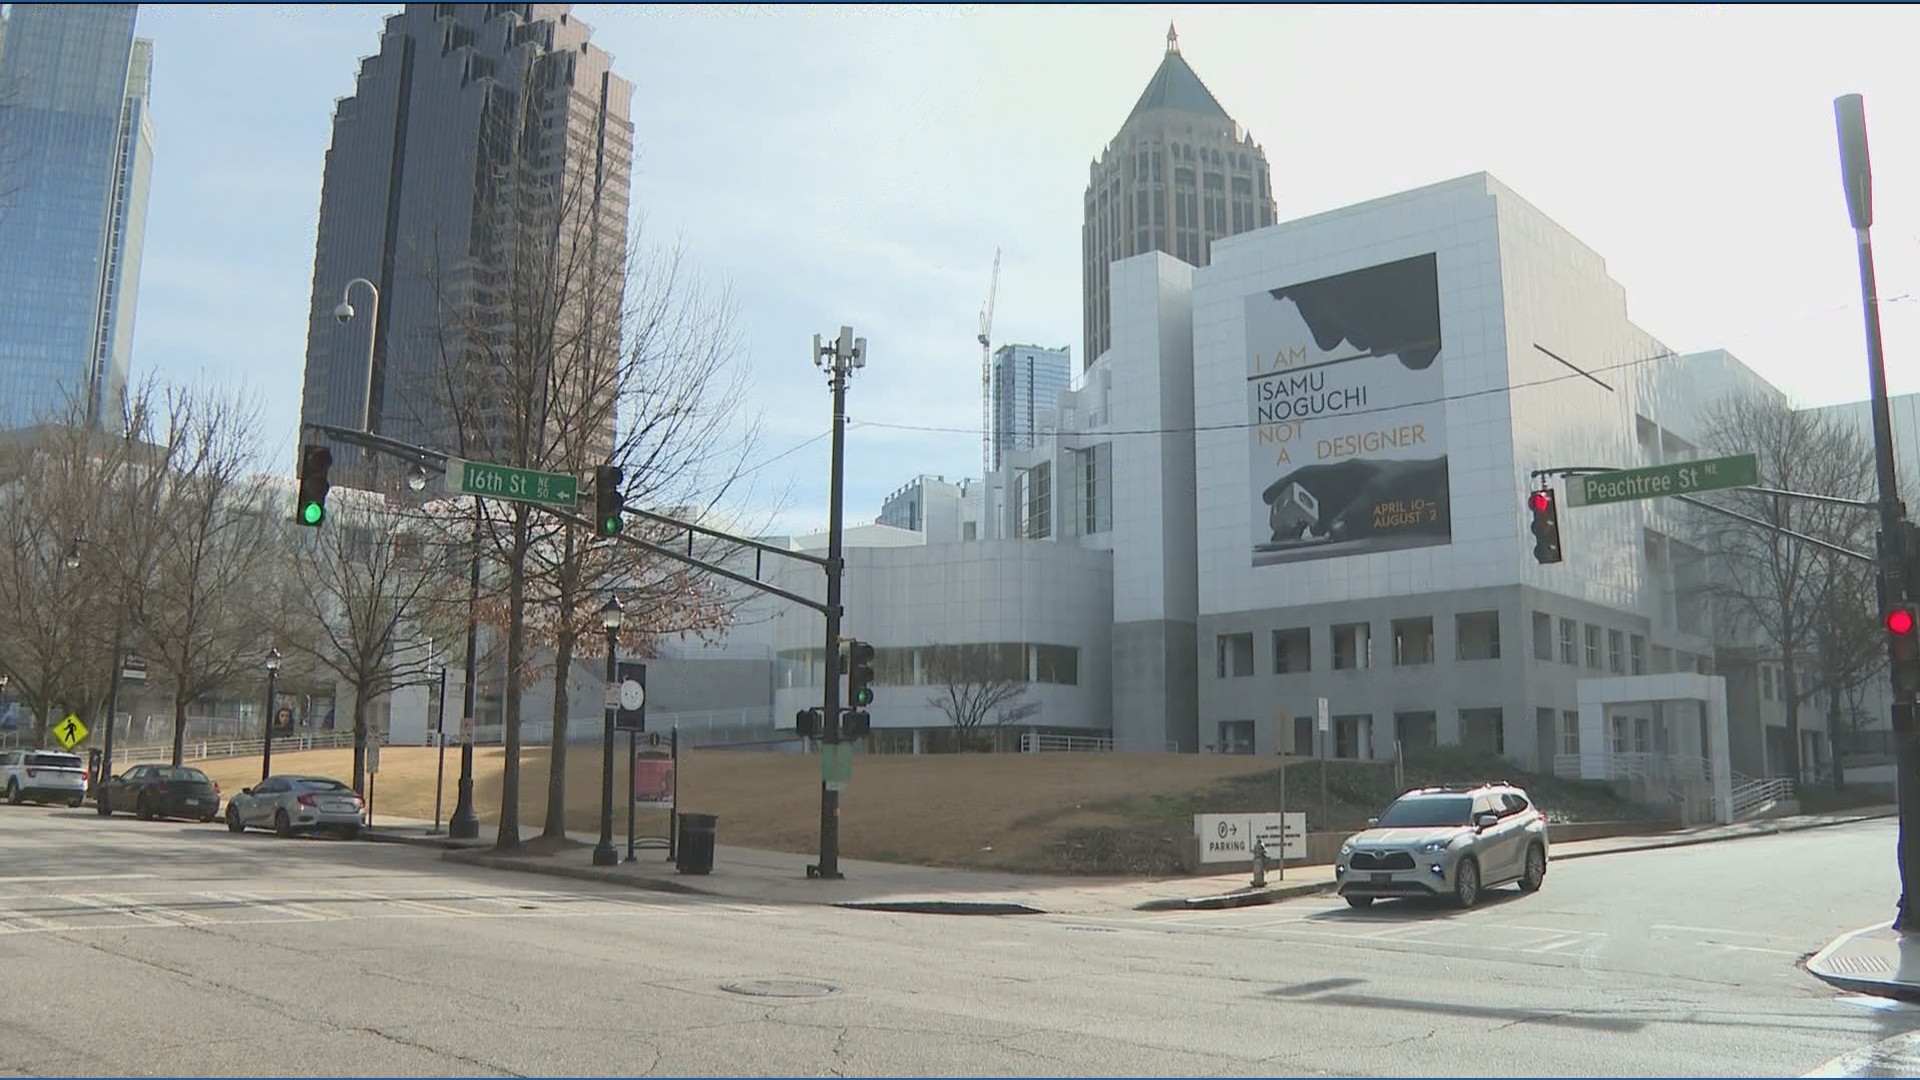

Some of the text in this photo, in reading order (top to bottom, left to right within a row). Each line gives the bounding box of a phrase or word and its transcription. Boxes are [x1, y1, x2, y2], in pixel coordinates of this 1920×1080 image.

[1256, 345, 1307, 373] I AM
[1257, 371, 1325, 402] ISAMU
[1257, 386, 1367, 424] NOGUCHI
[1258, 419, 1305, 446] NOT
[1276, 424, 1427, 467] A DESIGNER
[468, 468, 527, 495] 16th St
[1587, 464, 1719, 500] Peachtree St NE
[1373, 500, 1406, 516] APRIL
[1373, 511, 1421, 529] AUGUST
[1209, 841, 1246, 852] PARKING
